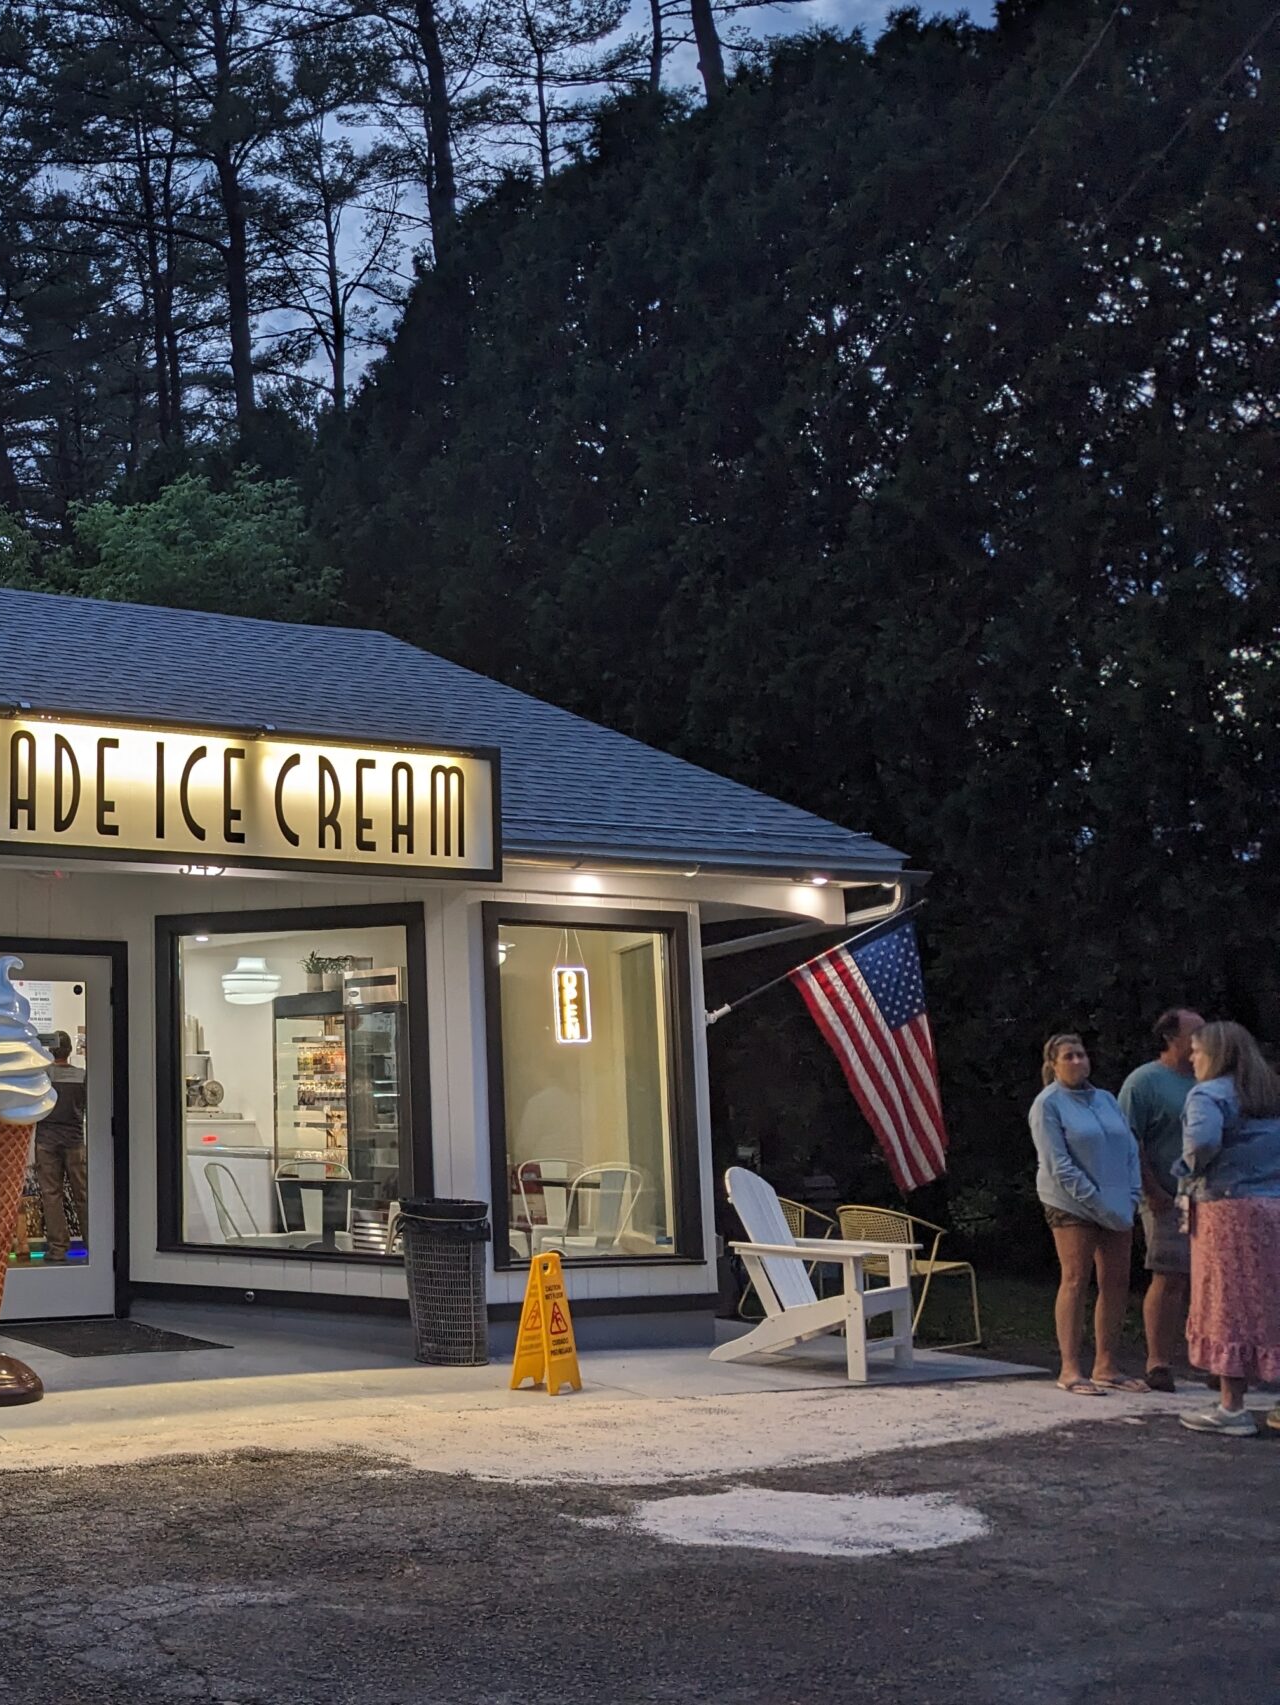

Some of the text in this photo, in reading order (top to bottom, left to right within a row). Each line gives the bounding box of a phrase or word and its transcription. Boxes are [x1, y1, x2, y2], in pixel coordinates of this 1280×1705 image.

[155, 740, 246, 843] ICE
[274, 752, 466, 858] CREAM
[562, 971, 580, 1039] OPEN
